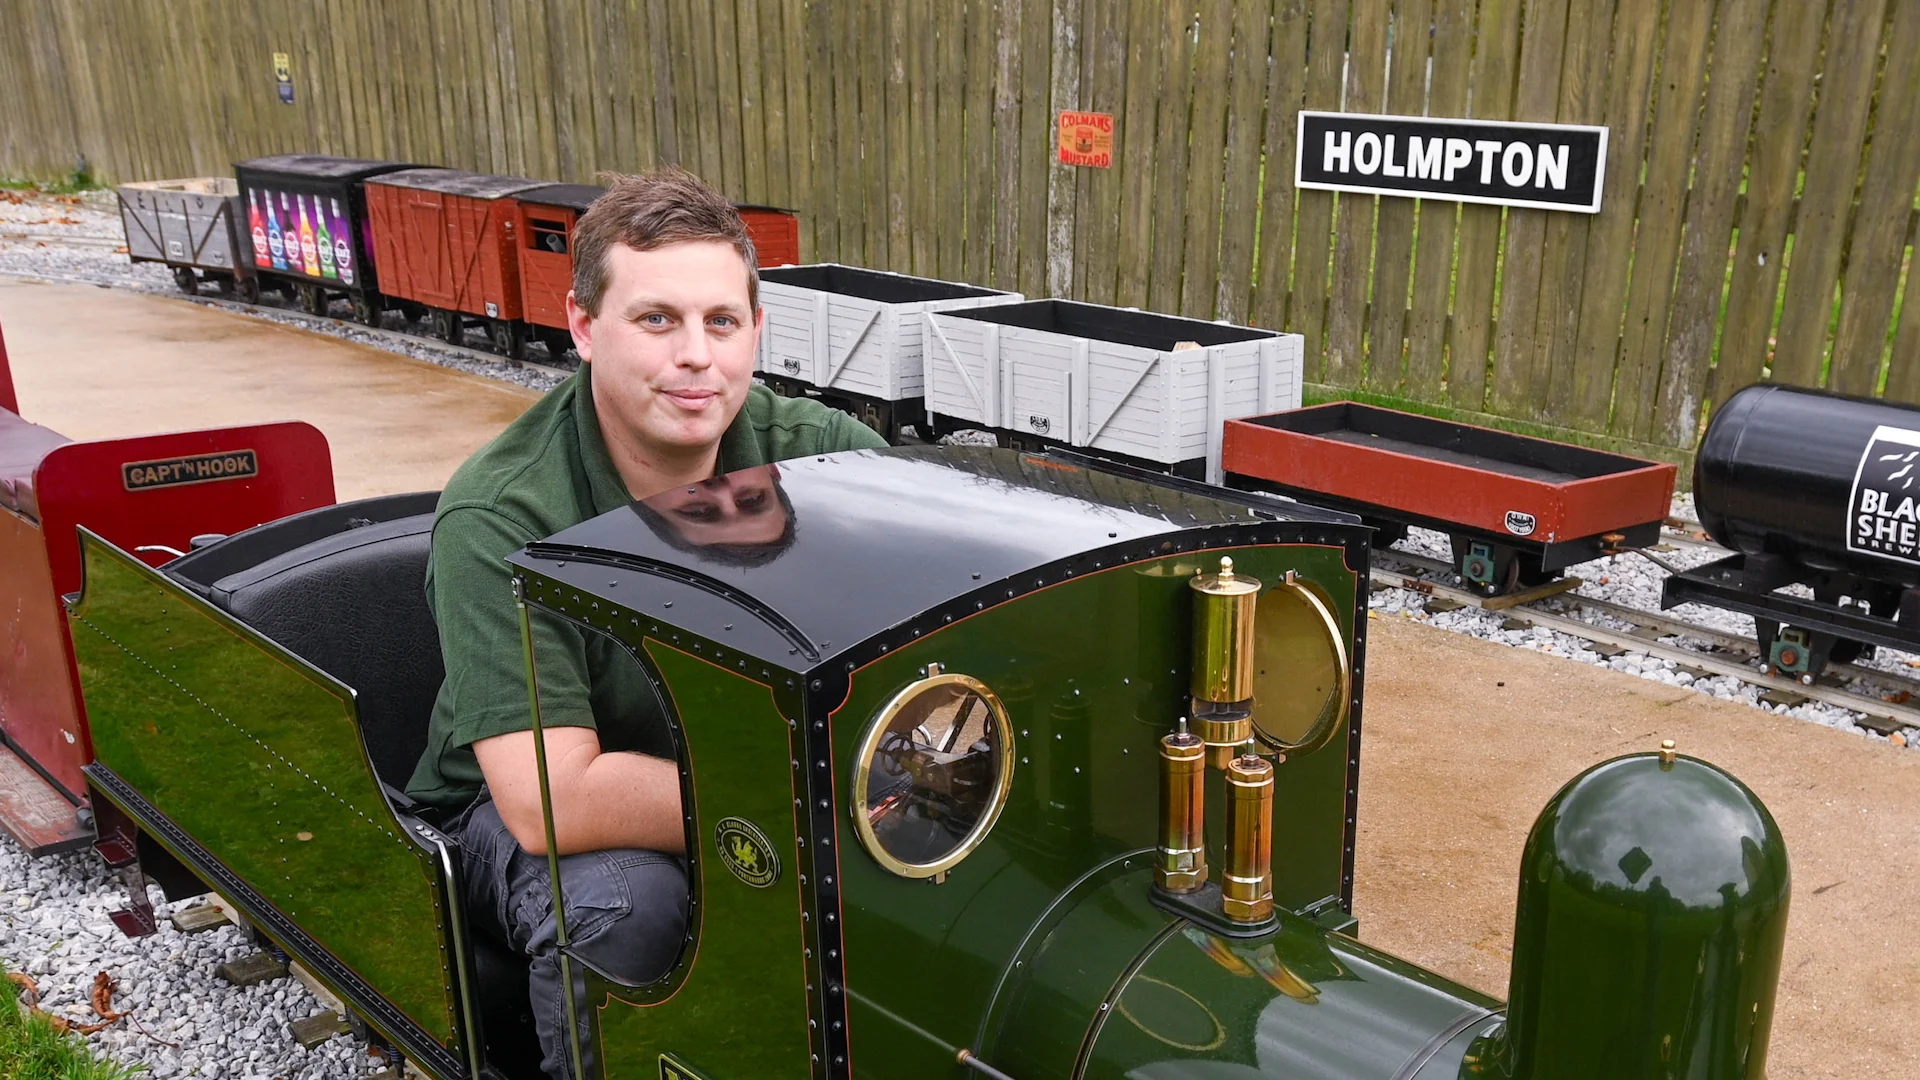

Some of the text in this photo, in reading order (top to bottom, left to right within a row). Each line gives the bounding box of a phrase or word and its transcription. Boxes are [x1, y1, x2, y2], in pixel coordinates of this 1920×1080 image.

[1061, 146, 1109, 167] MUSTARD
[1323, 131, 1570, 190] HOLMPTON
[197, 456, 251, 477] HOOK
[1858, 514, 1920, 547] SHE
[1857, 536, 1920, 557] BREW
